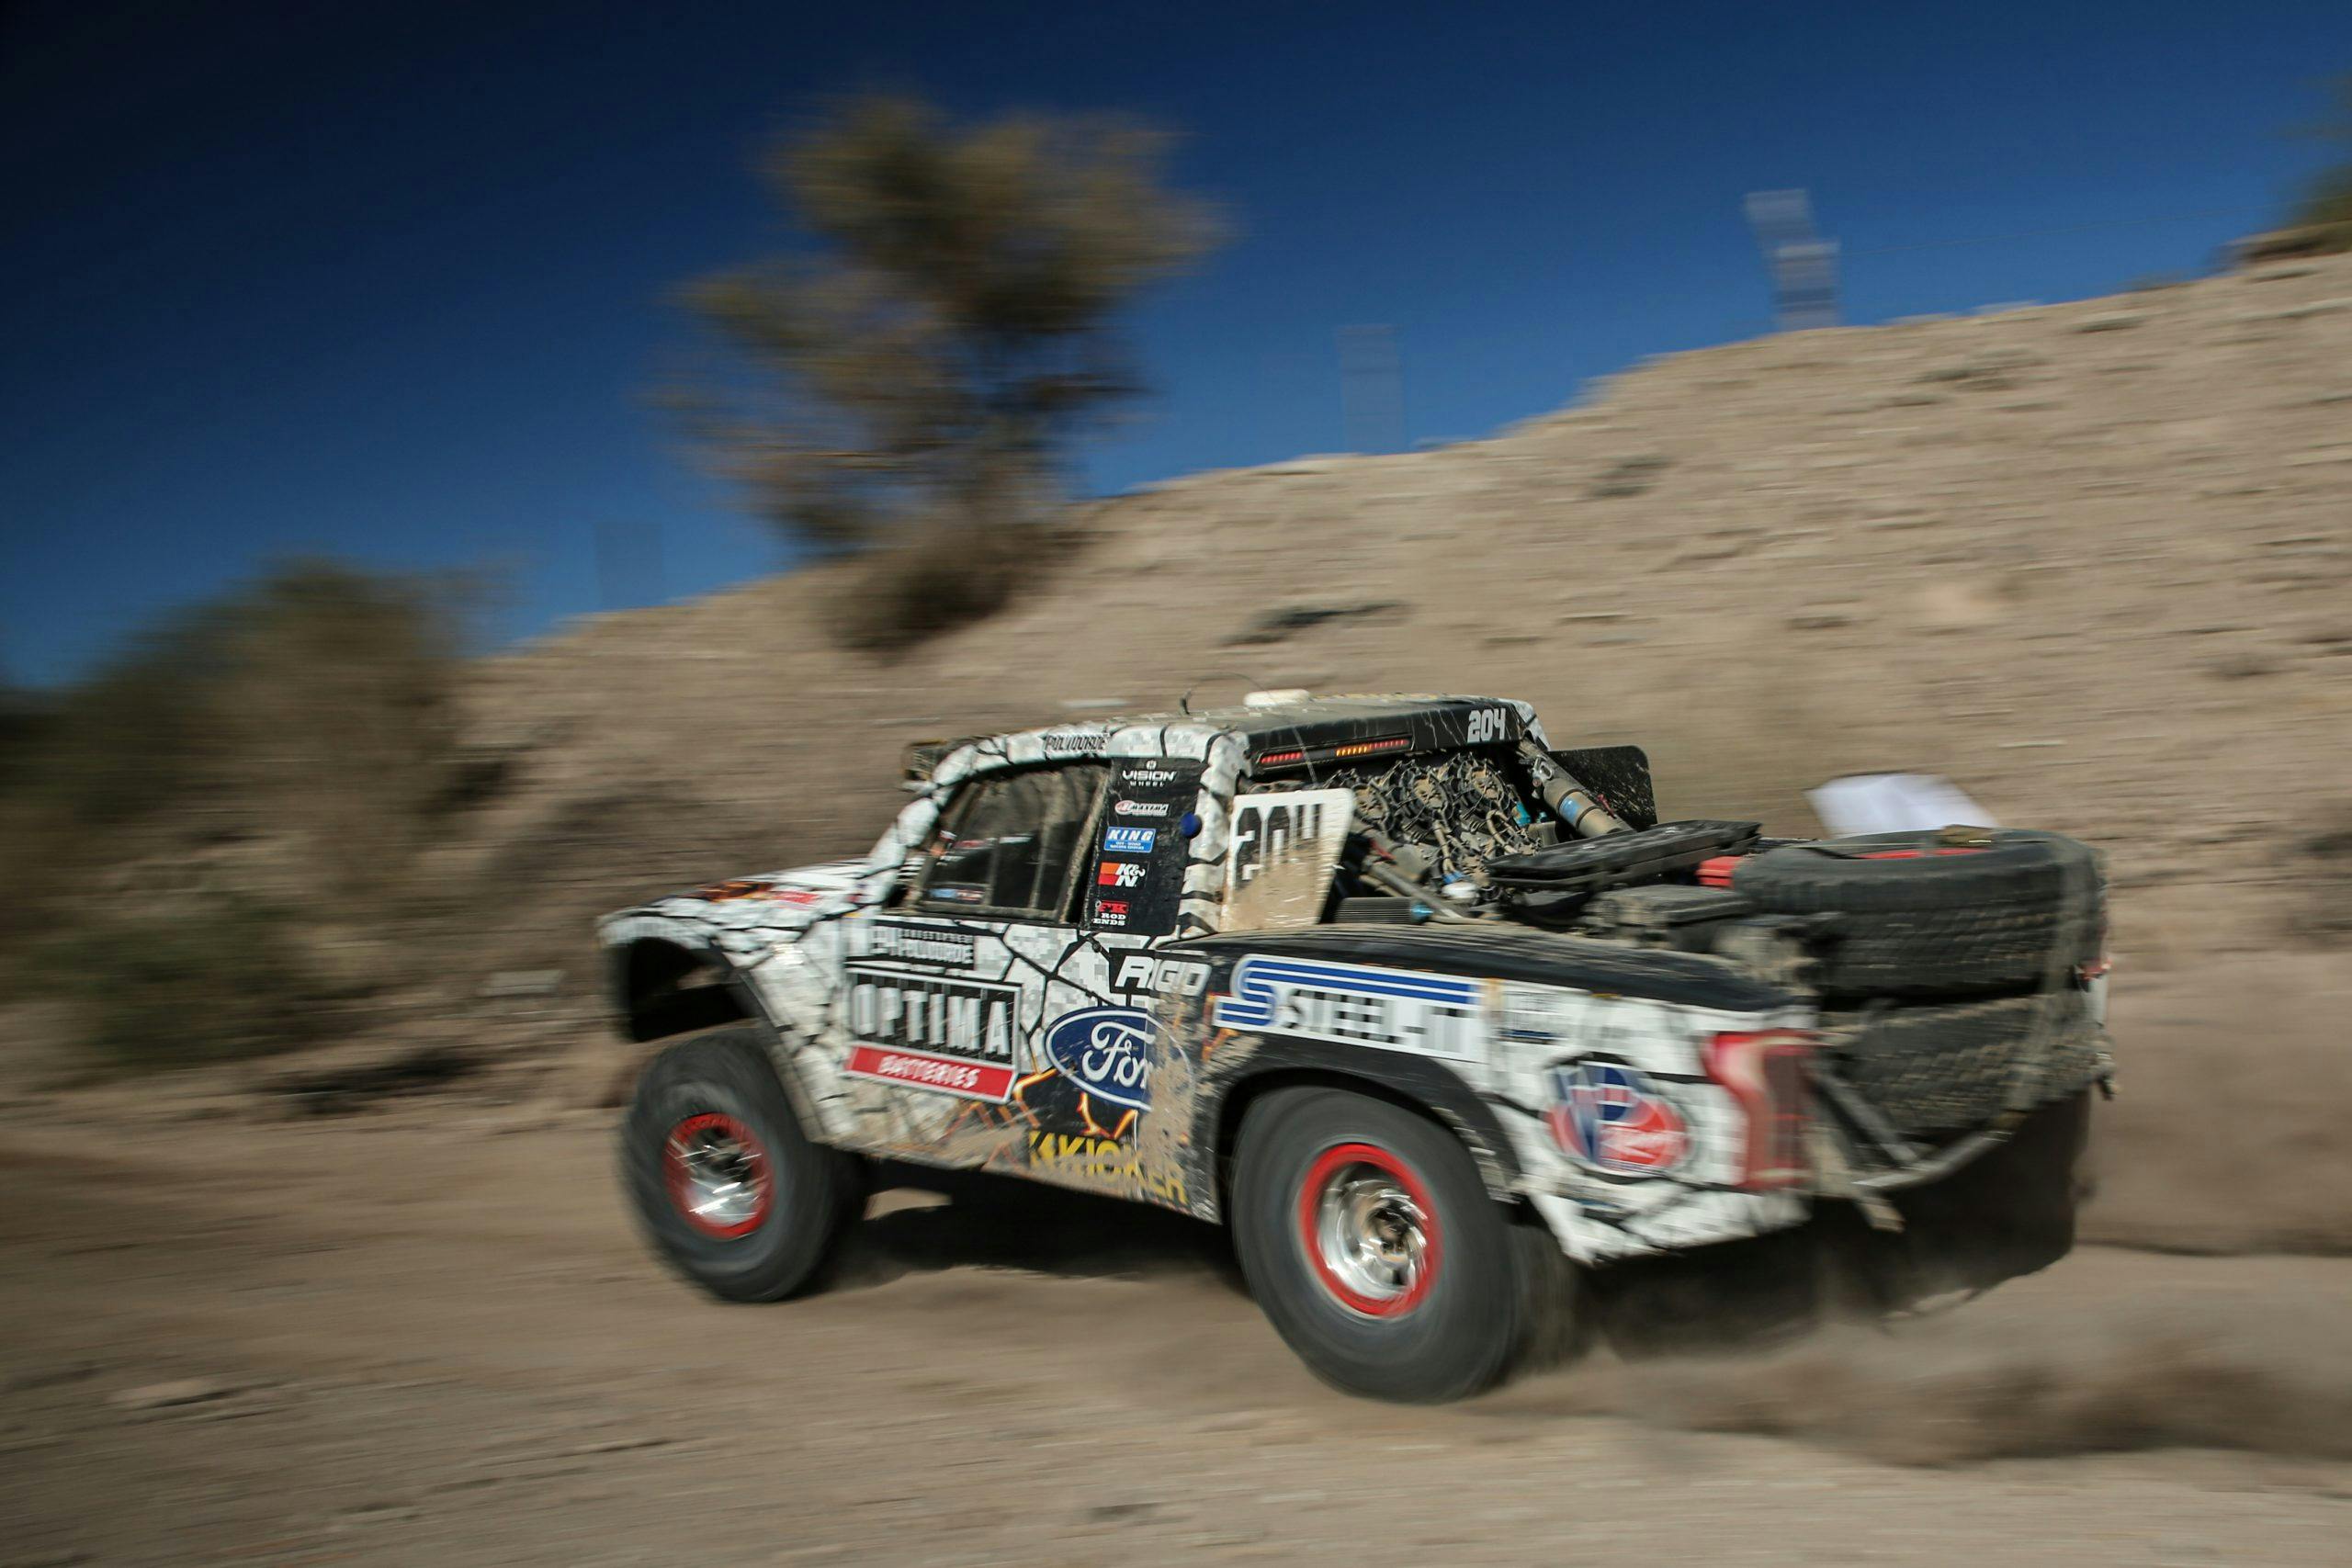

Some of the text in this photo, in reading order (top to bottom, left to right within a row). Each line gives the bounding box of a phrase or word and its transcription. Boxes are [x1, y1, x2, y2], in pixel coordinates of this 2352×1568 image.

[1467, 707, 1506, 743] 204
[1122, 770, 1177, 782] VISION
[1108, 829, 1153, 841] KING
[1114, 863, 1146, 887] K&N
[1098, 902, 1128, 914] FK
[1092, 918, 1125, 926] ENDS
[851, 982, 1012, 1056] OPTIMA
[877, 1055, 981, 1089] BATTERIES
